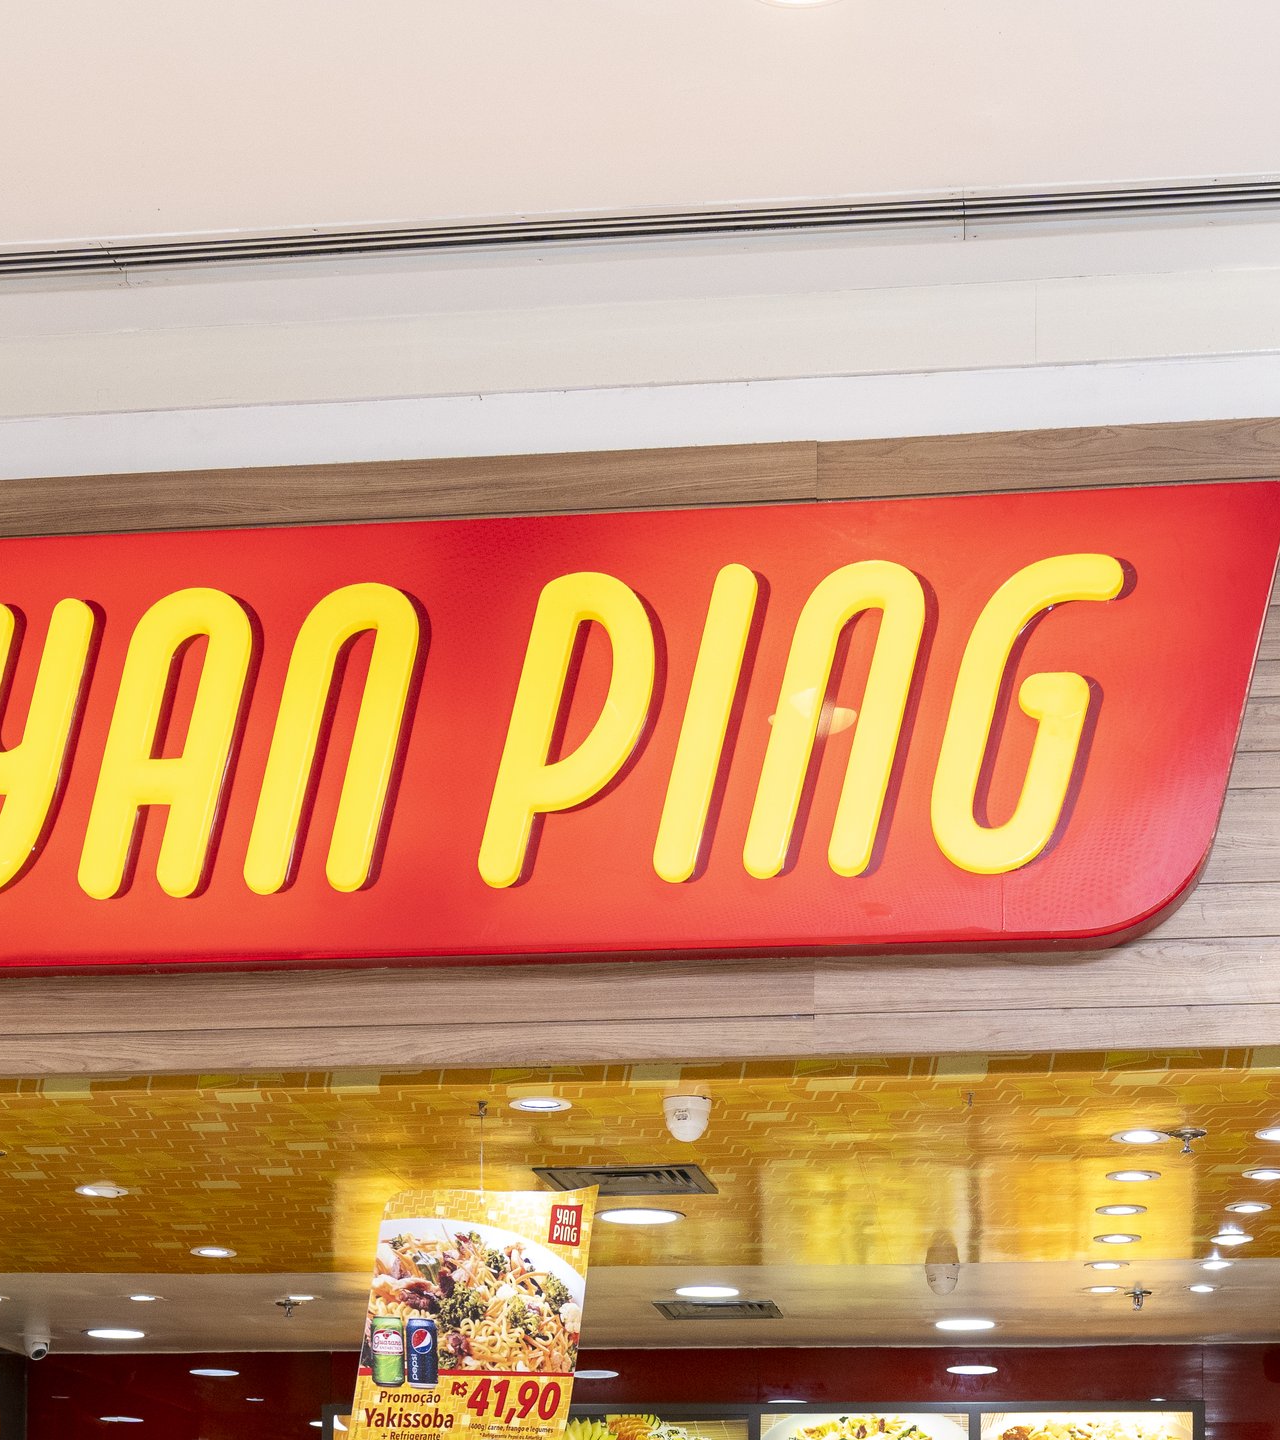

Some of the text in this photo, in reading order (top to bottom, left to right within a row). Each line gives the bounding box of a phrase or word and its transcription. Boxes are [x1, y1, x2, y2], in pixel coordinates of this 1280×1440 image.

[477, 552, 1125, 890] PING
[555, 1208, 576, 1226] YAN
[552, 1224, 578, 1243] PING
[410, 1353, 419, 1381] pepsi
[379, 1378, 561, 1425] Promoção R$ 41,90
[364, 1407, 455, 1429] Yakissoba
[506, 1425, 525, 1434] frango
[530, 1426, 554, 1434] legumes
